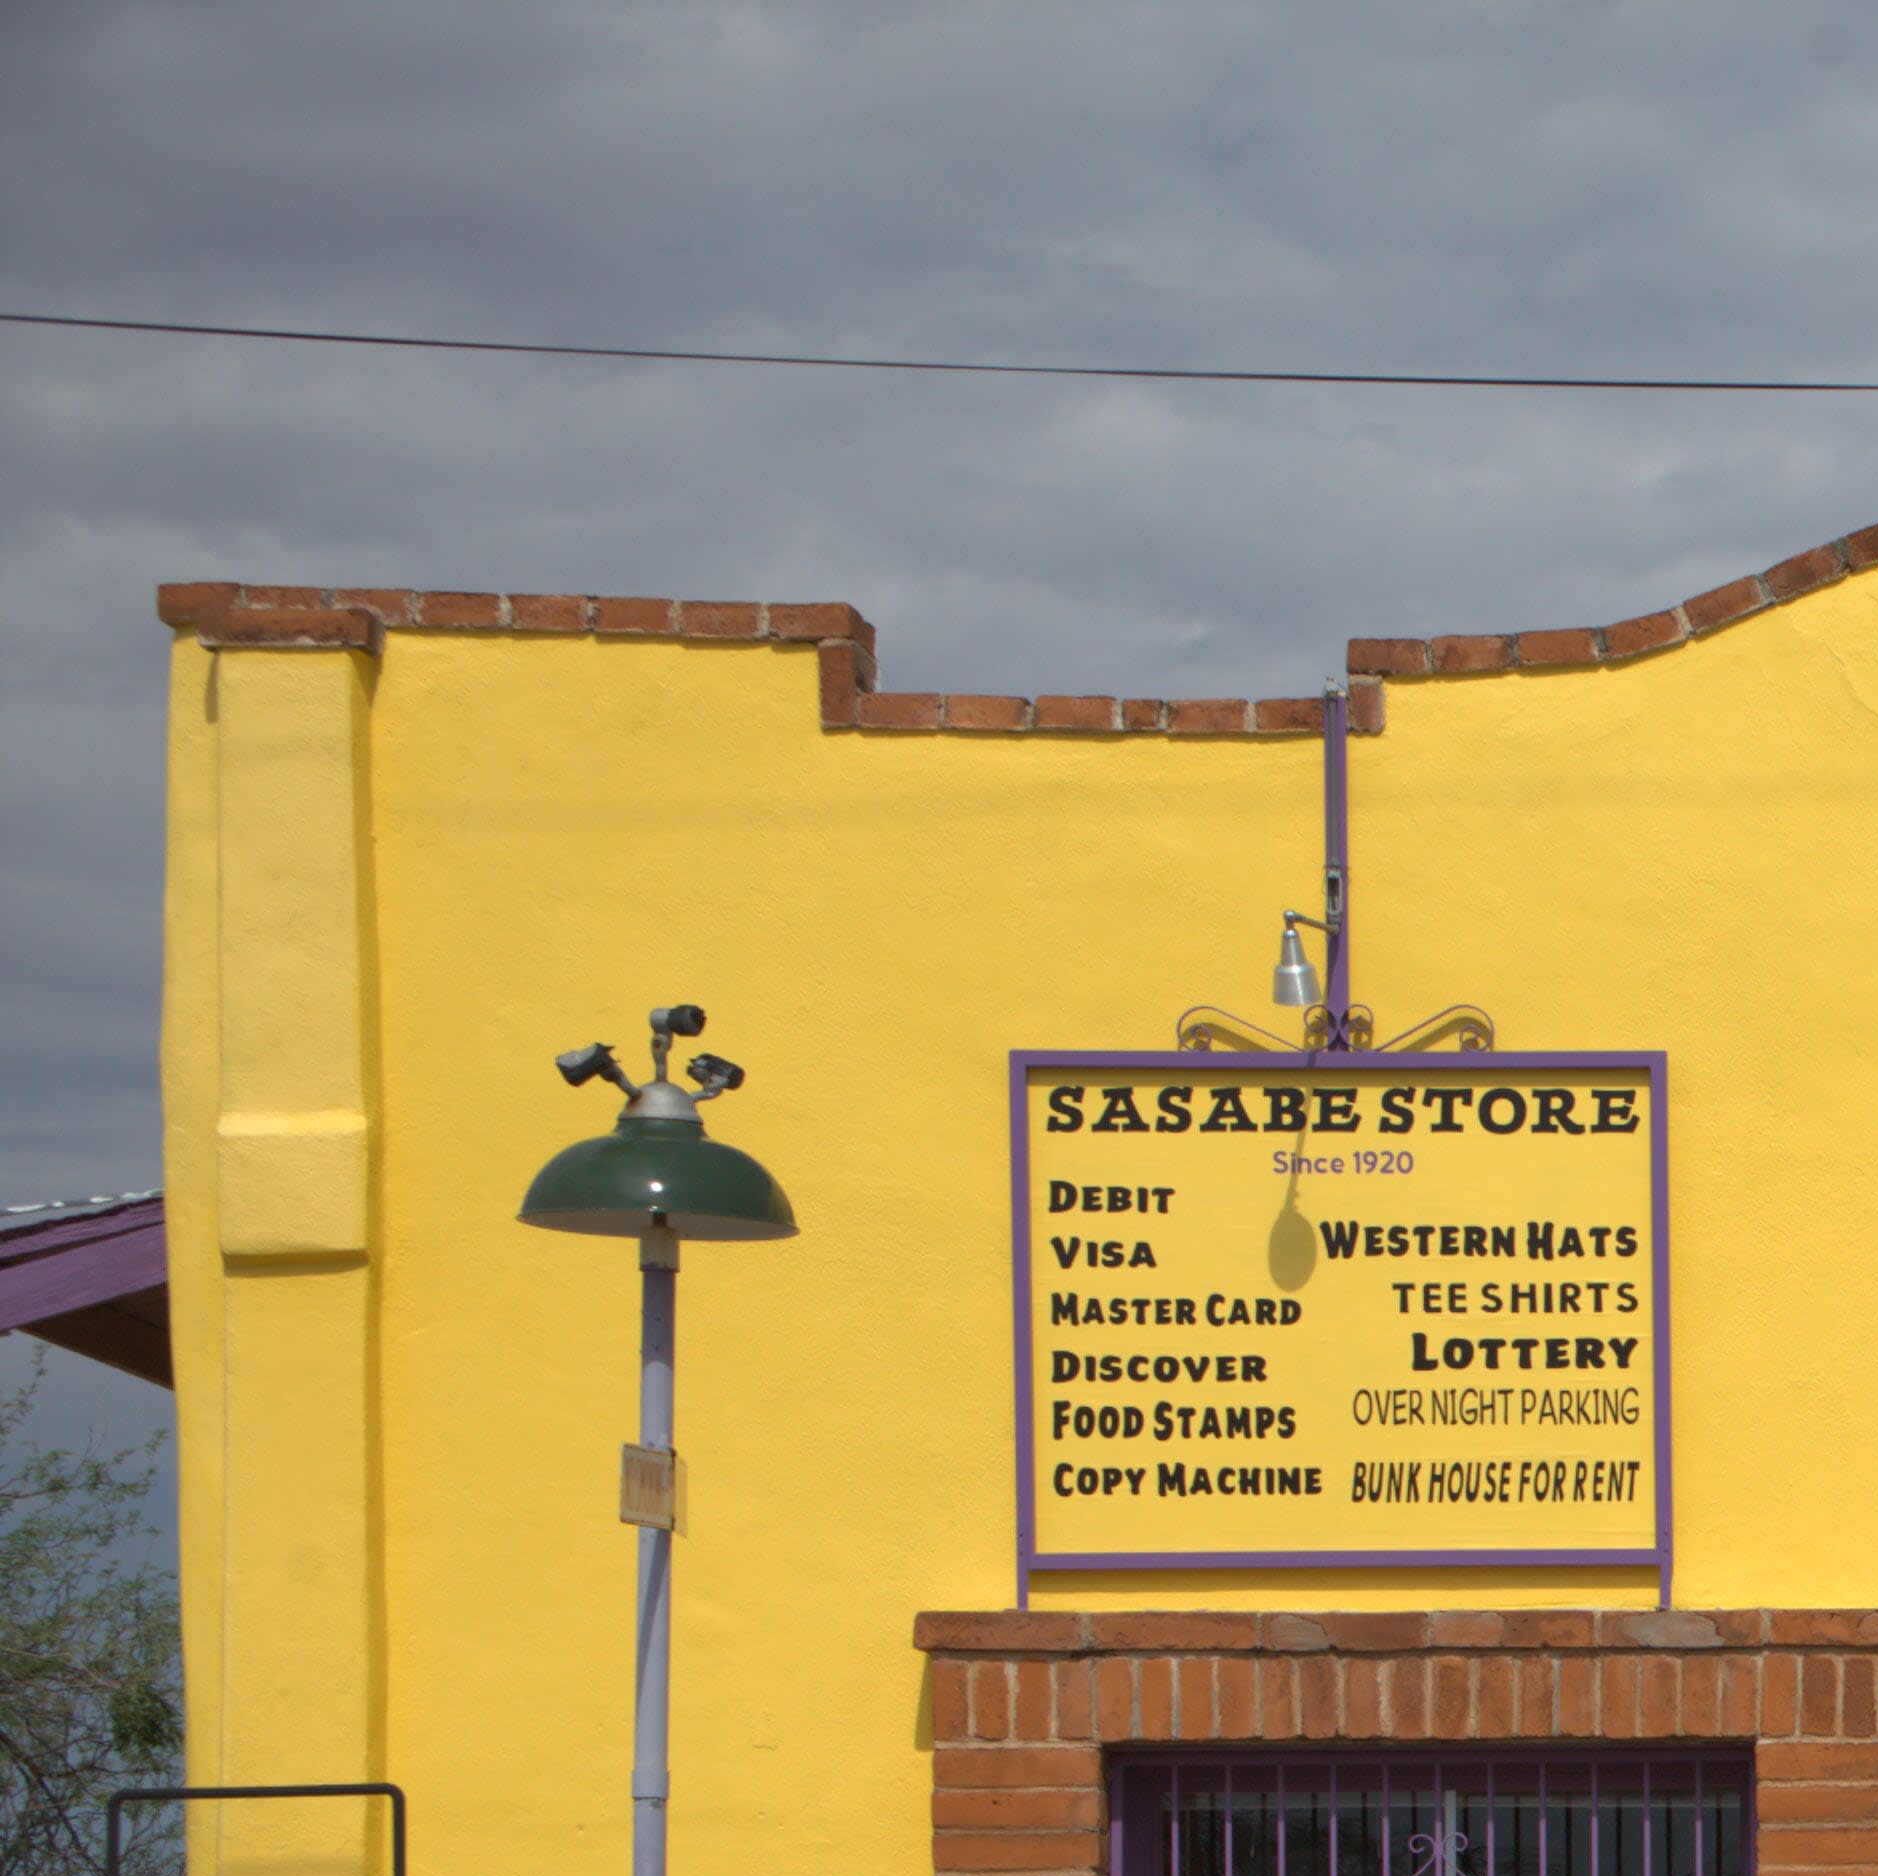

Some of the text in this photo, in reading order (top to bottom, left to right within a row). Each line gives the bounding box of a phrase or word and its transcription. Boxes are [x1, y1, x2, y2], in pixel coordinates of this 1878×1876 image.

[1046, 1086, 1640, 1134] SASABE STORE
[1272, 1151, 1414, 1174] Since 1920
[1048, 1181, 1175, 1213] DEBIT
[1050, 1237, 1157, 1269] VISA
[1320, 1221, 1638, 1260] WESTERN HATS
[1050, 1293, 1302, 1327] MASTER CARD
[1392, 1283, 1639, 1314] TEE SHIRTS
[1051, 1351, 1267, 1383] DISCOVER
[1411, 1333, 1639, 1371] LOTTERY
[1053, 1401, 1297, 1442] FOOD STAMPS
[1353, 1389, 1640, 1426] OVER NIGHT PARKING
[1053, 1463, 1323, 1498] COPY MACHINE
[1351, 1462, 1640, 1503] BUNK HOUSE FOR RENT
